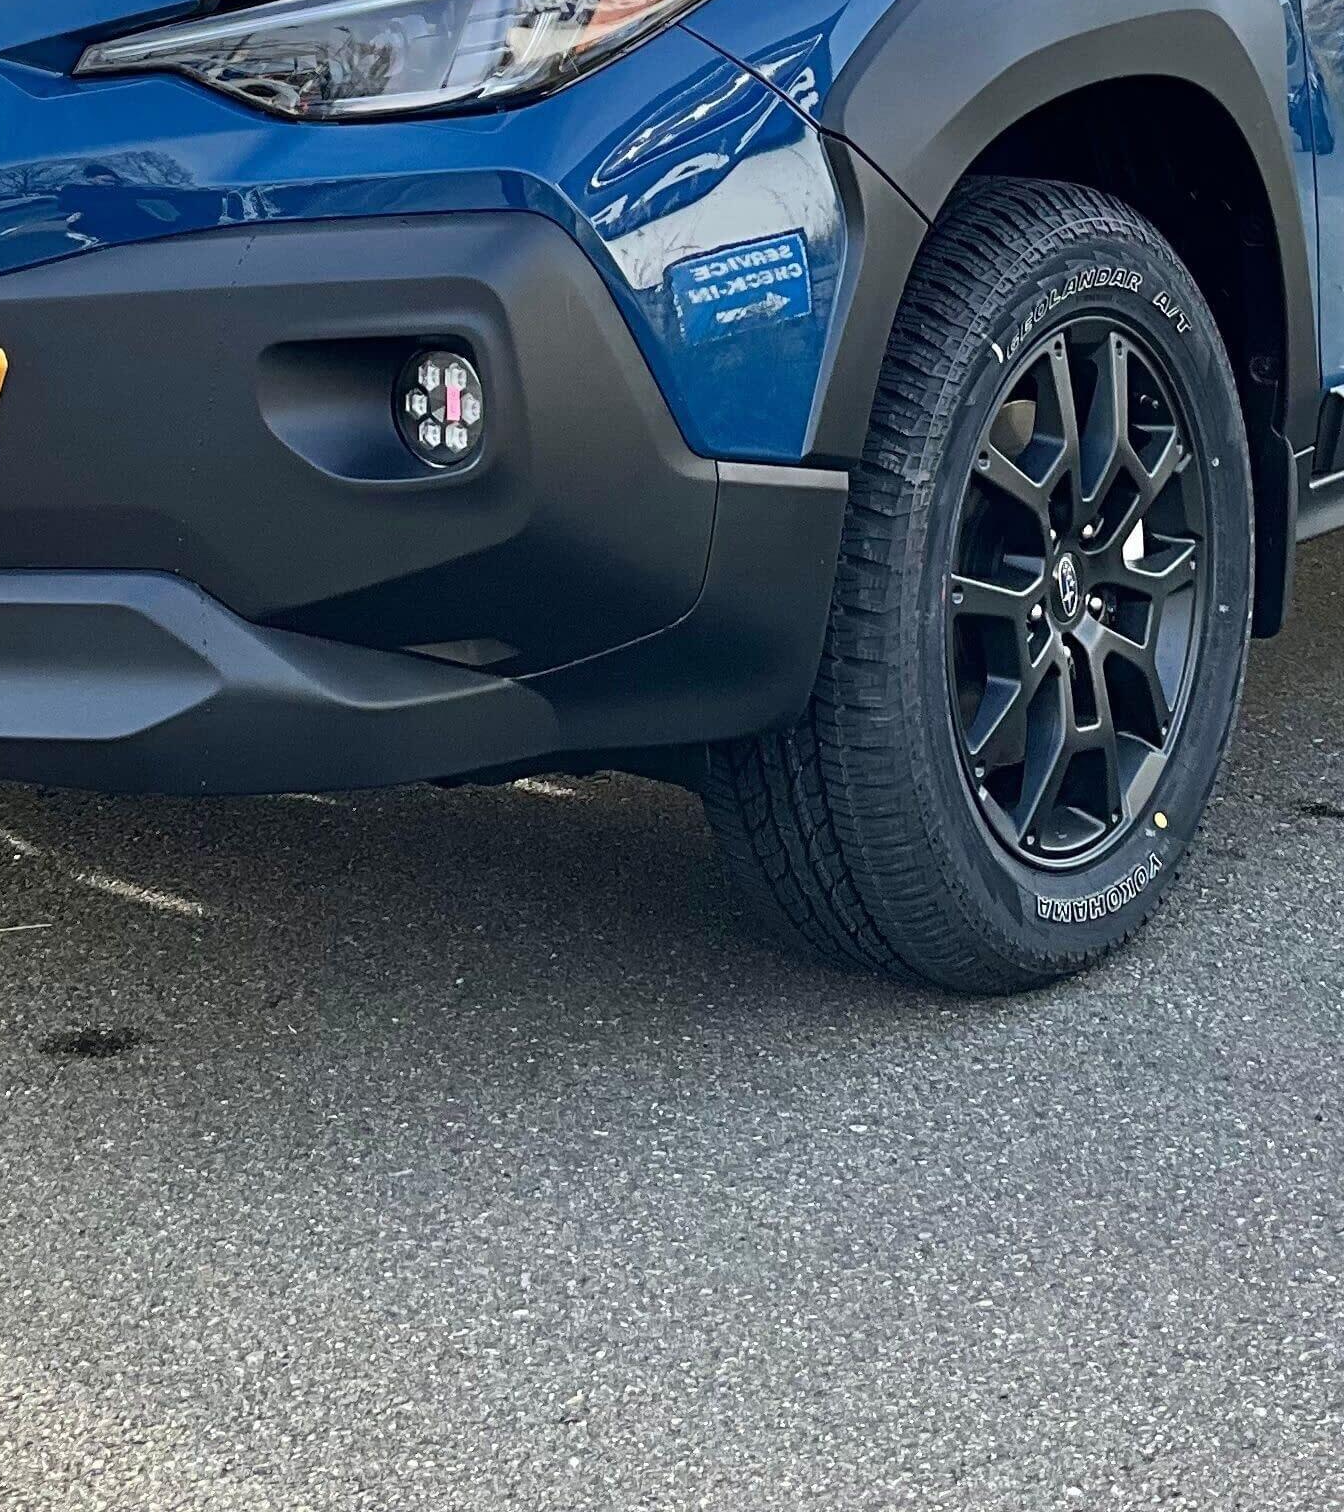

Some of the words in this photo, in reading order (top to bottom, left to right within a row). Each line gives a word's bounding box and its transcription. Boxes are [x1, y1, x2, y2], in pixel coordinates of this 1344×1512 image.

[1006, 267, 1143, 360] GEOLANDAR
[1152, 291, 1193, 334] A/T
[1037, 852, 1163, 923] YOKOHAMA
